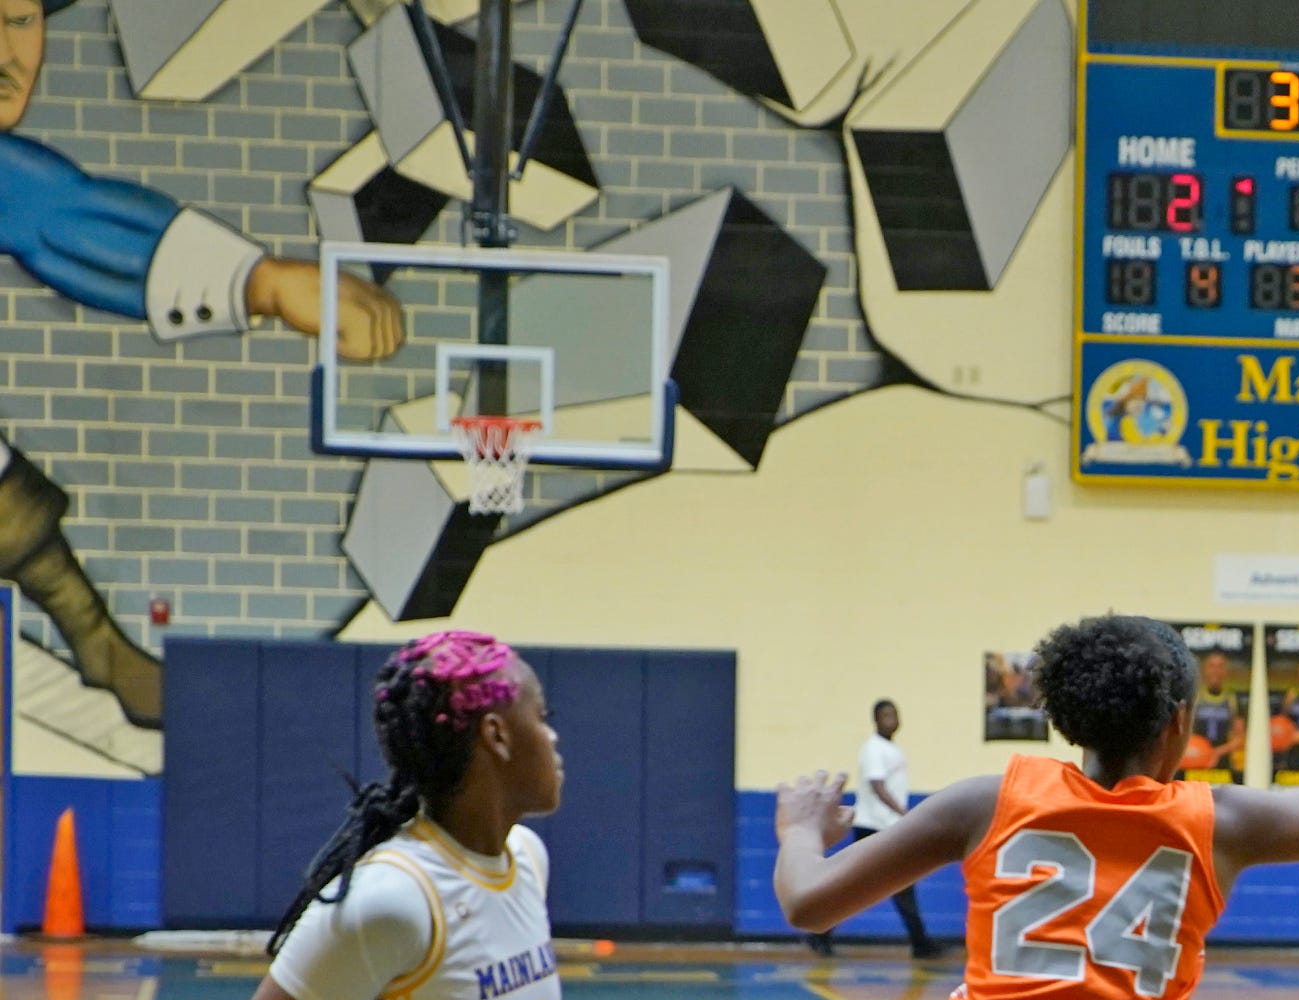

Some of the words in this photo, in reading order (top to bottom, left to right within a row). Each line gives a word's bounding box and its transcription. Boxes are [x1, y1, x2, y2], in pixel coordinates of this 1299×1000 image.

[1118, 136, 1196, 167] HOME
[1102, 235, 1162, 259] FOULS
[1102, 312, 1162, 334] SCORE
[992, 828, 1193, 998] 24
[475, 942, 556, 1000] MAINLA
